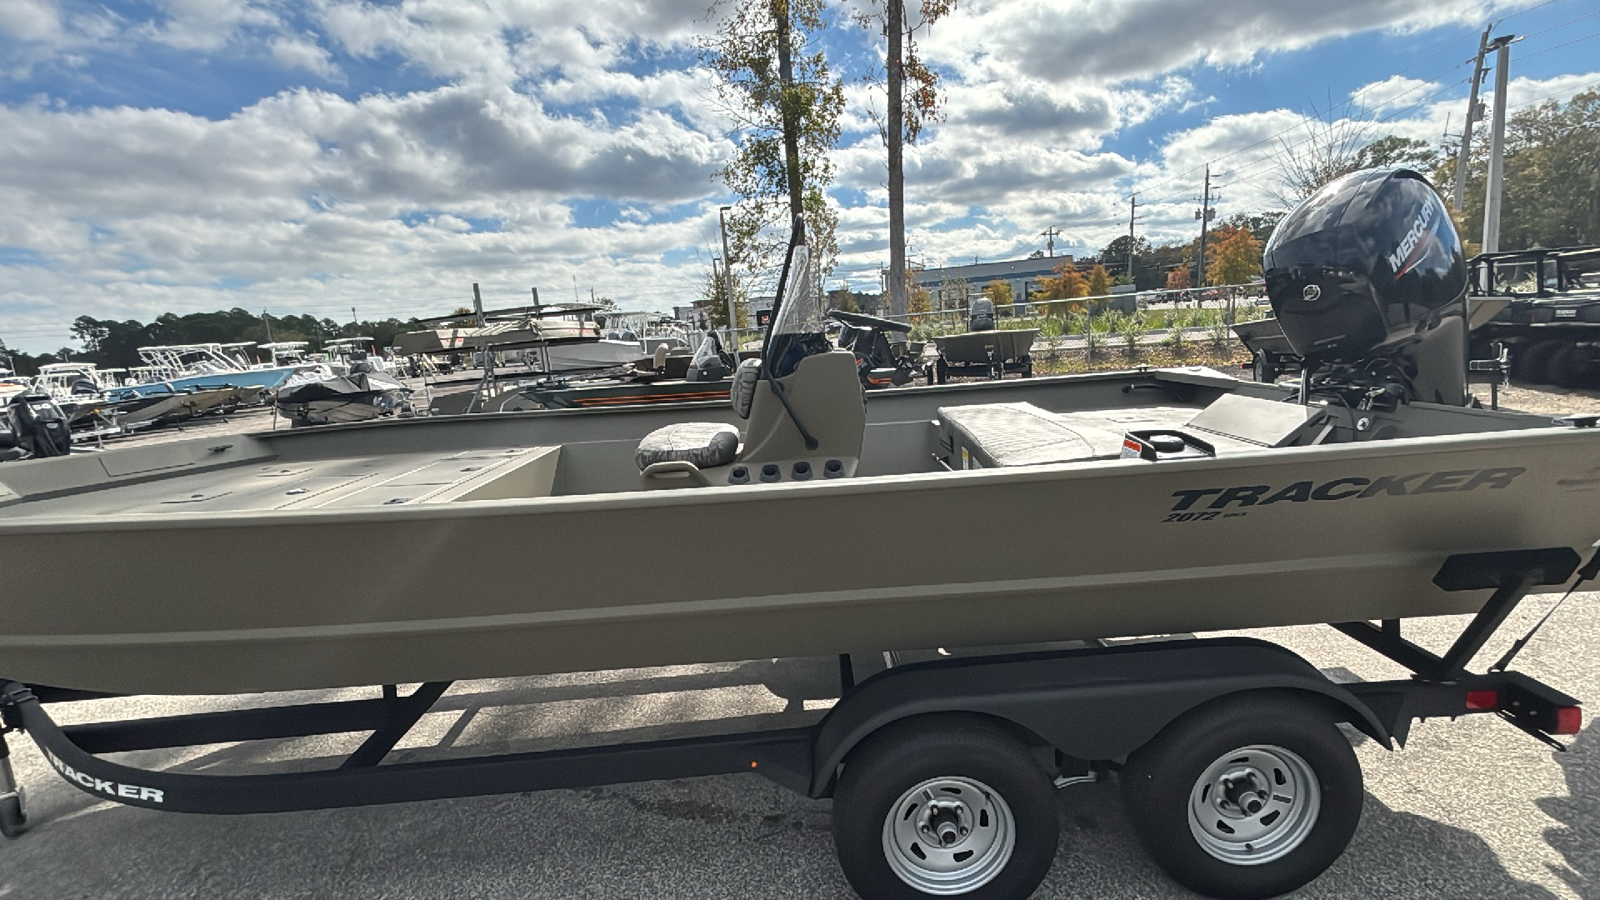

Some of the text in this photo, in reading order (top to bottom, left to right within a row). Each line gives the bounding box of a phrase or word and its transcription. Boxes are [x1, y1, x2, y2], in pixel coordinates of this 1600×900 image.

[1389, 195, 1434, 273] MERCURY
[1170, 466, 1527, 511] TRACKER
[1161, 511, 1222, 523] 2072
[45, 746, 164, 803] TRACKER
